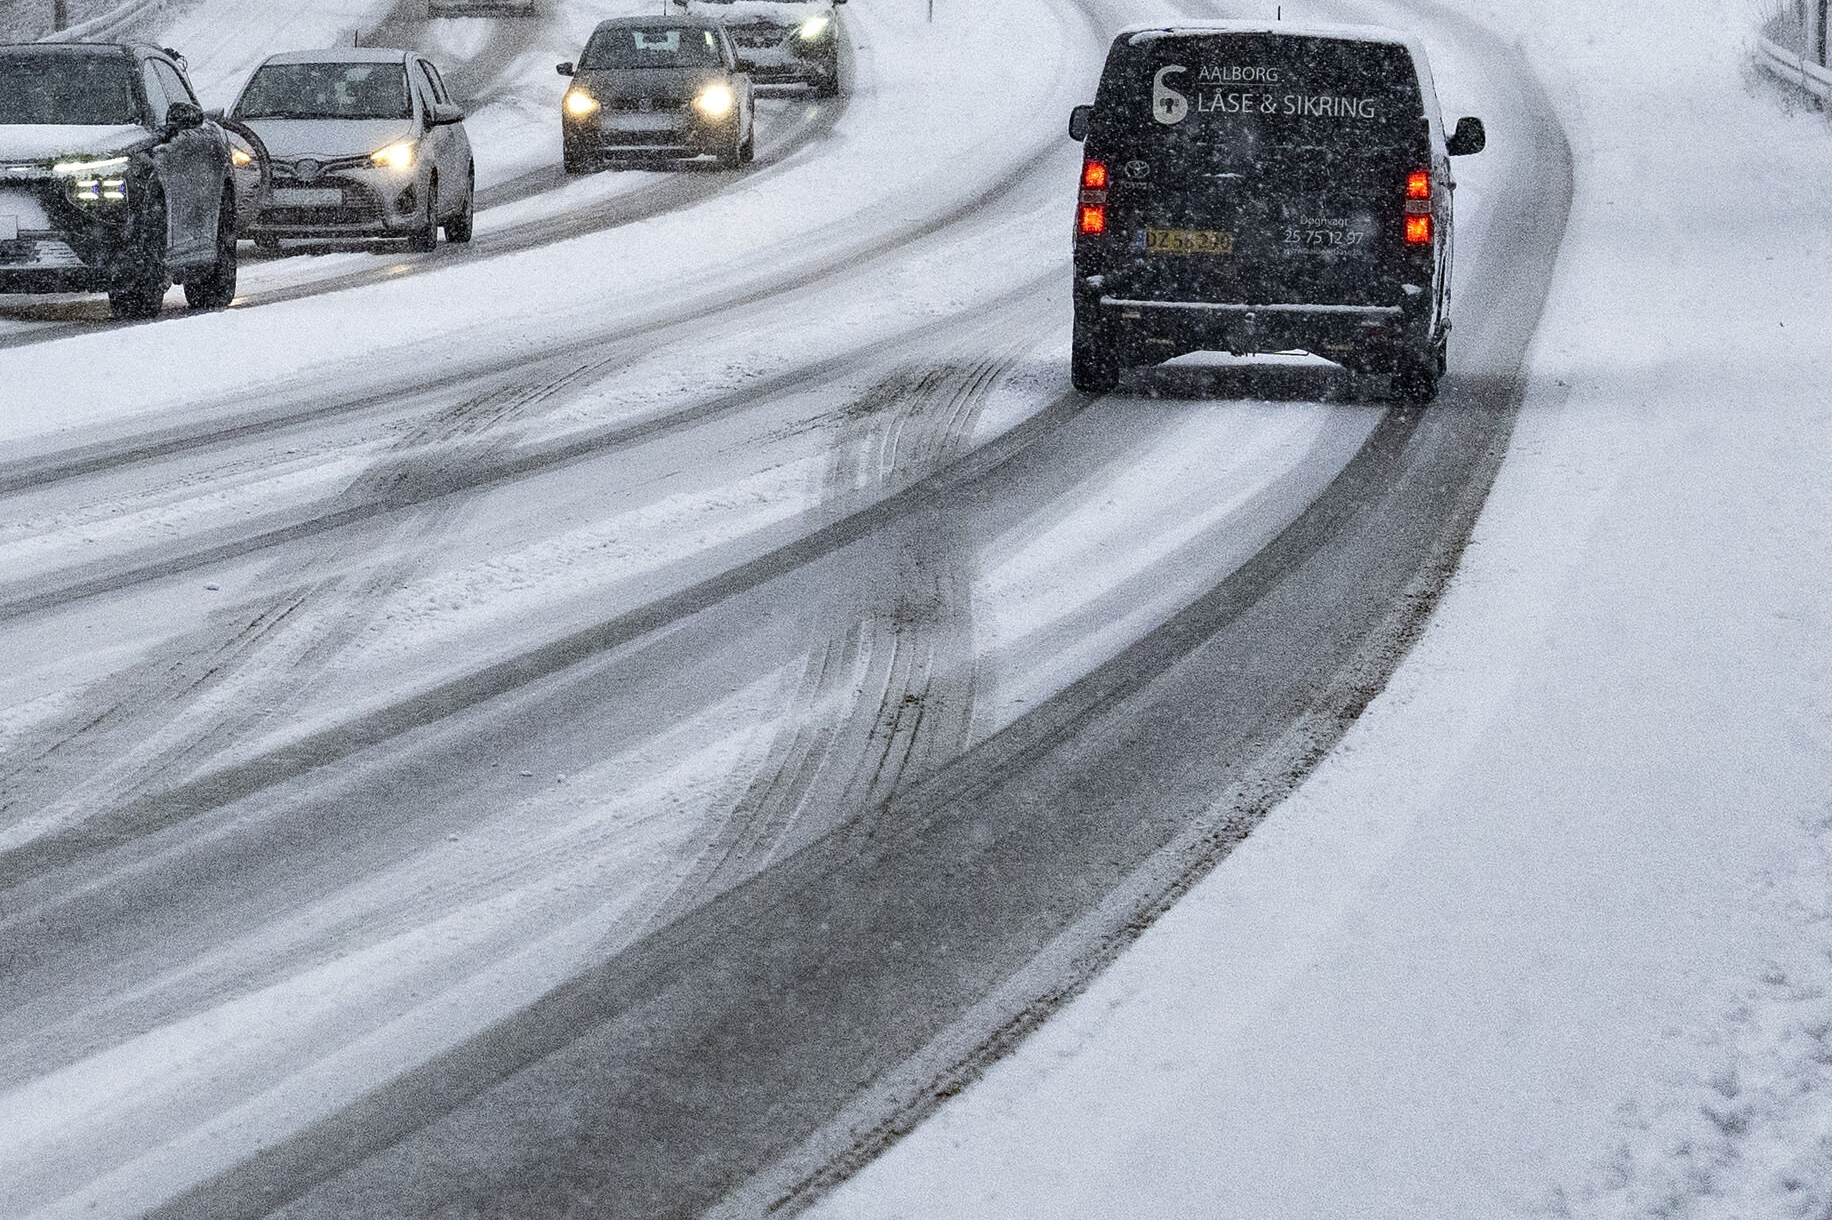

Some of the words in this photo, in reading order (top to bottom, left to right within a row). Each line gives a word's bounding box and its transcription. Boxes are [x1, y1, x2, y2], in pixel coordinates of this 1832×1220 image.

[1199, 66, 1279, 82] AALBORG
[1198, 88, 1254, 113] LÅSE
[1260, 94, 1278, 114] &
[1283, 95, 1376, 119] SIKRING
[1284, 229, 1302, 243] 25
[1305, 230, 1324, 245] 75
[1327, 230, 1343, 245] 12
[1347, 230, 1364, 245] 97
